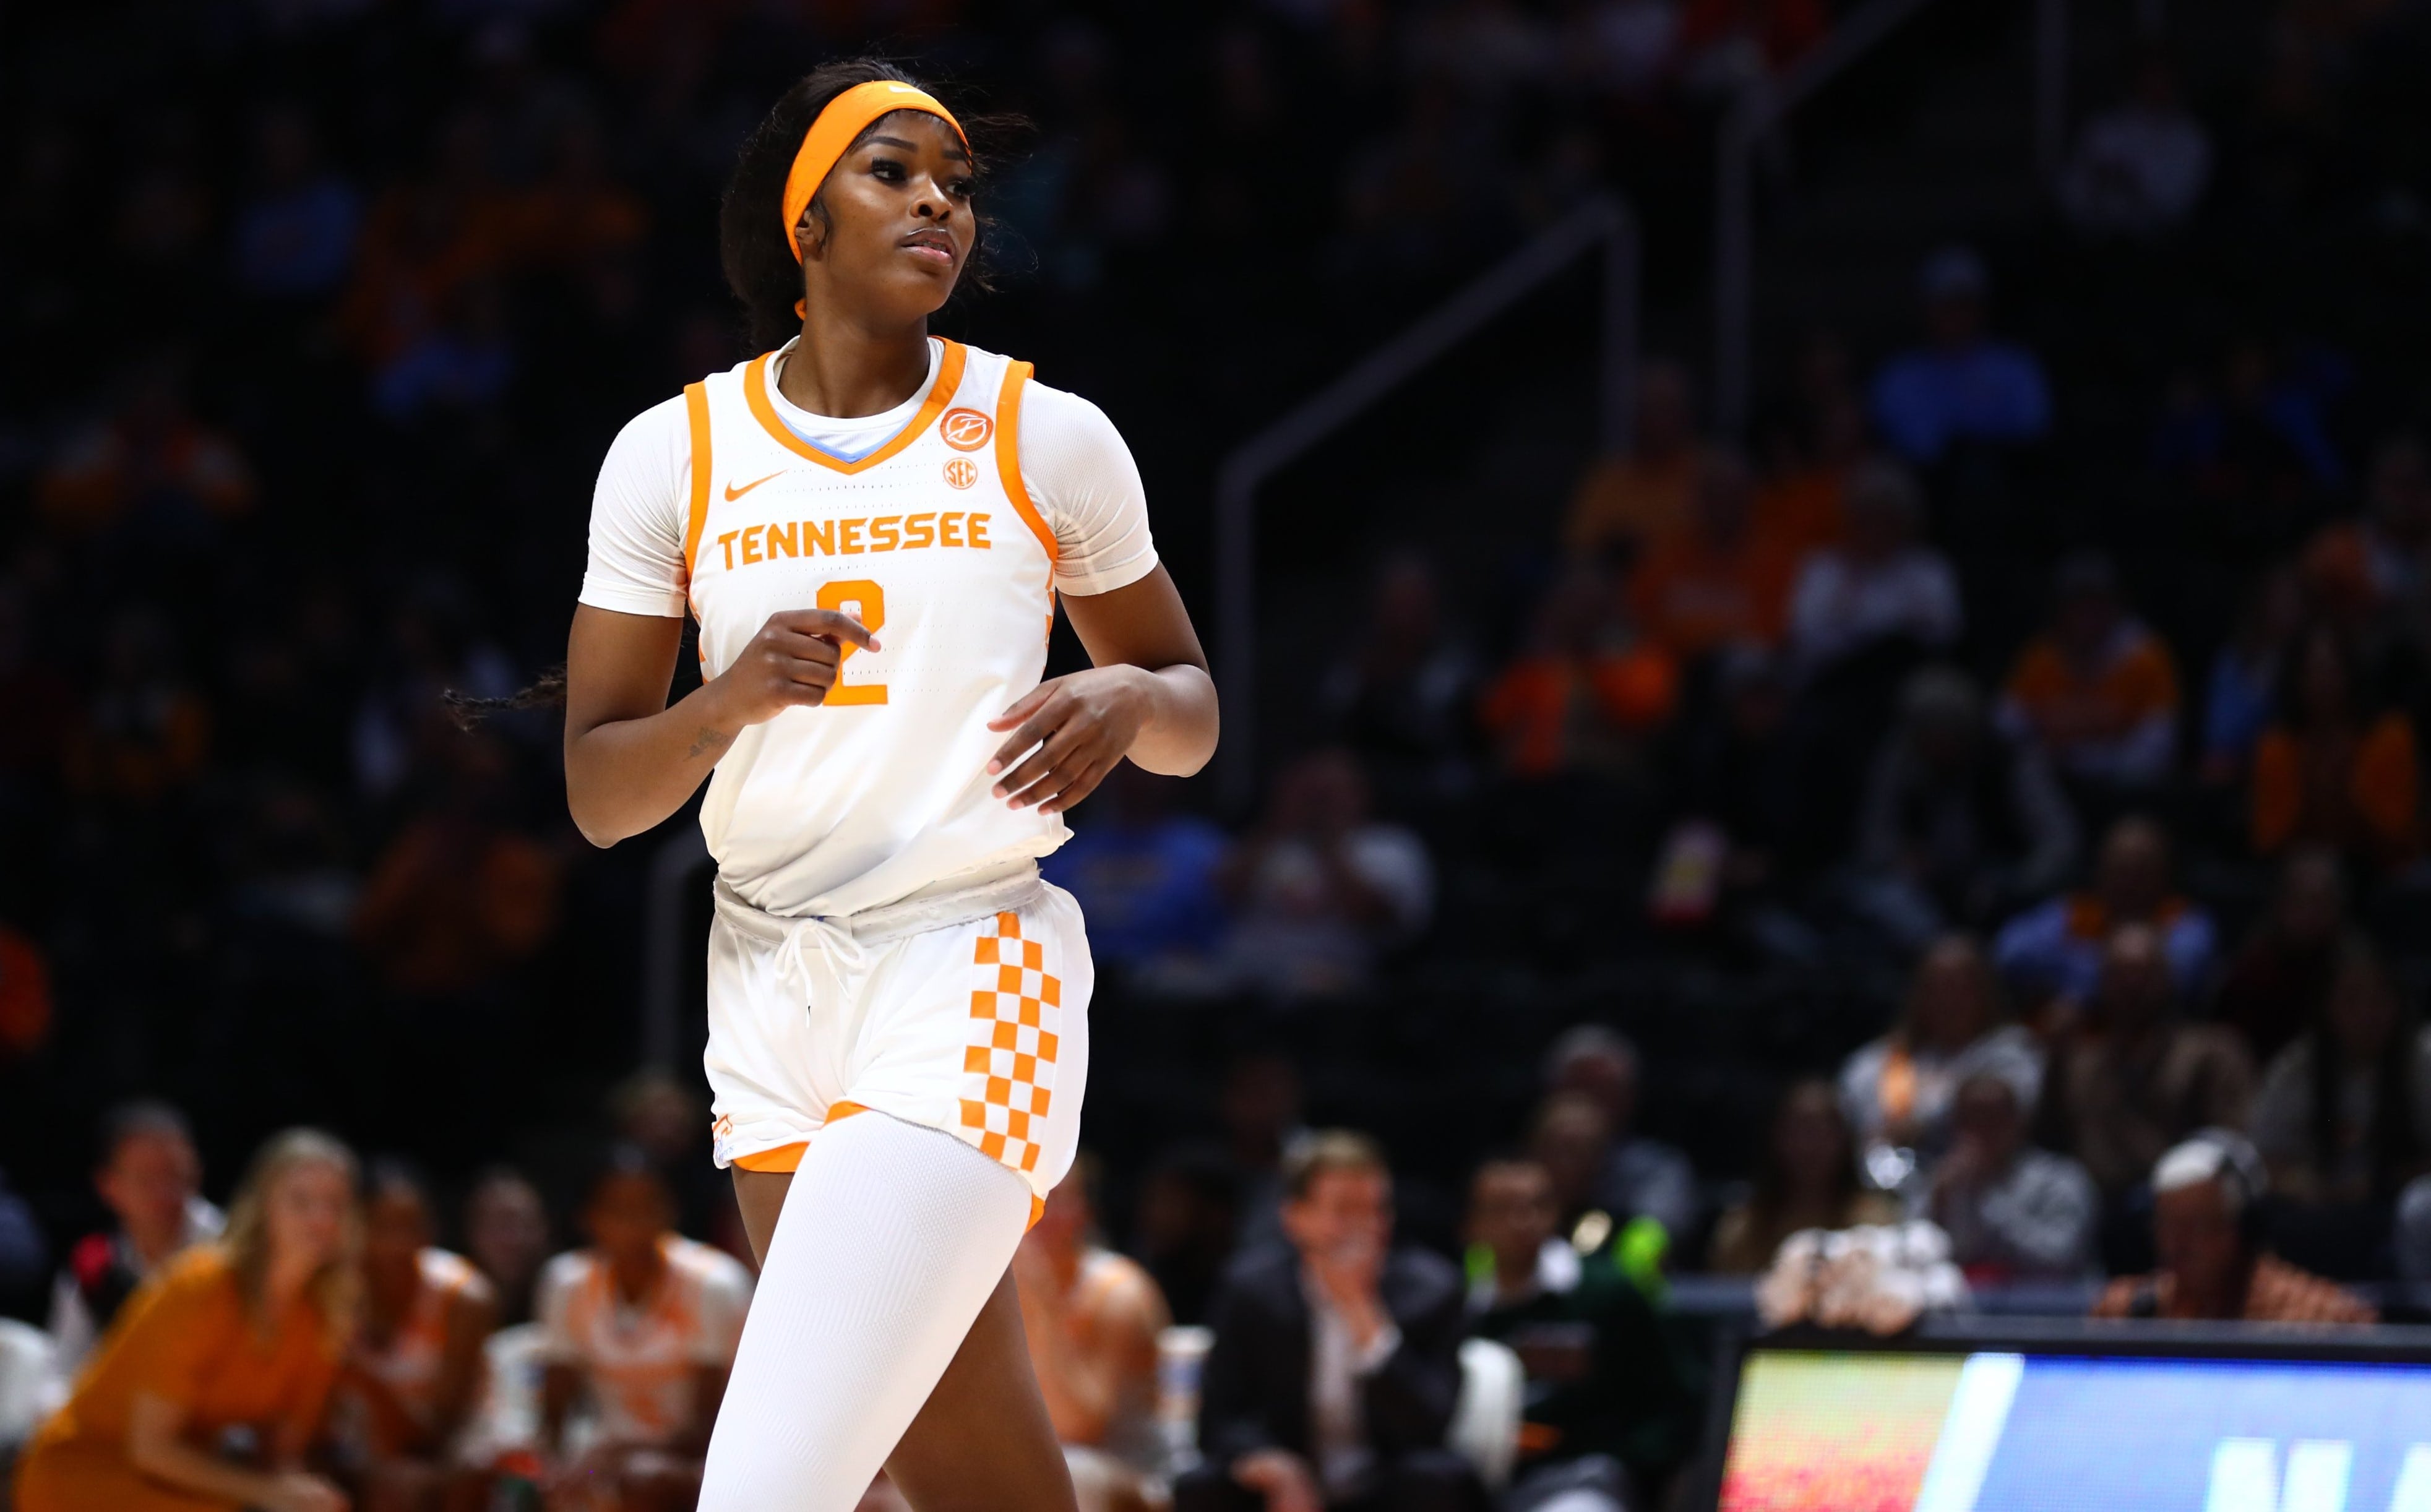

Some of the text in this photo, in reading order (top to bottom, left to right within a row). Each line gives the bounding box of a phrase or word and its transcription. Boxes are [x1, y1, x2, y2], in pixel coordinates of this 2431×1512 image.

[947, 460, 974, 486] SEC
[718, 512, 991, 570] TENNESSEE
[816, 579, 888, 707] 2
